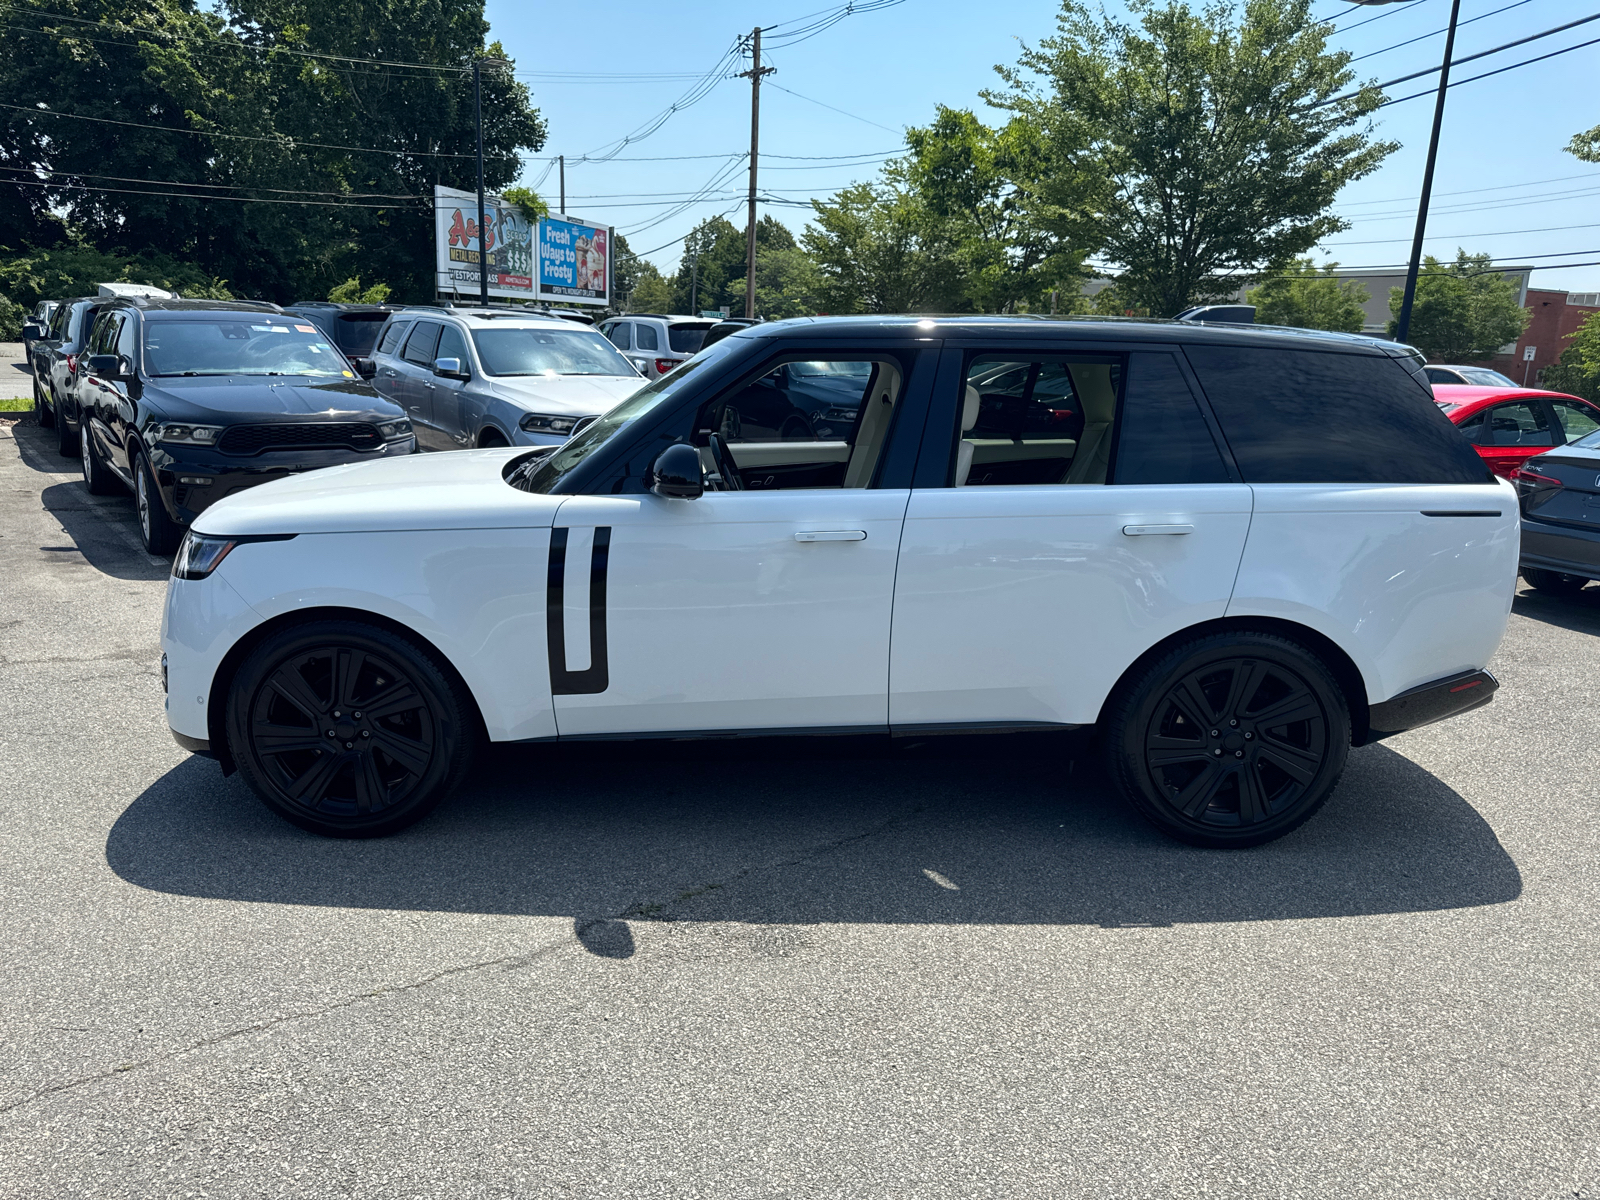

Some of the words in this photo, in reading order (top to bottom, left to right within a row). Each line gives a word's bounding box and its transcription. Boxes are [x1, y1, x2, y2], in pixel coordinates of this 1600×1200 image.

[507, 230, 527, 241] SCRAP
[546, 226, 570, 245] Fresh
[450, 248, 468, 262] METAL
[468, 251, 496, 265] RECYING
[541, 242, 565, 265] Ways
[566, 248, 575, 263] to
[544, 261, 573, 284] Frosty
